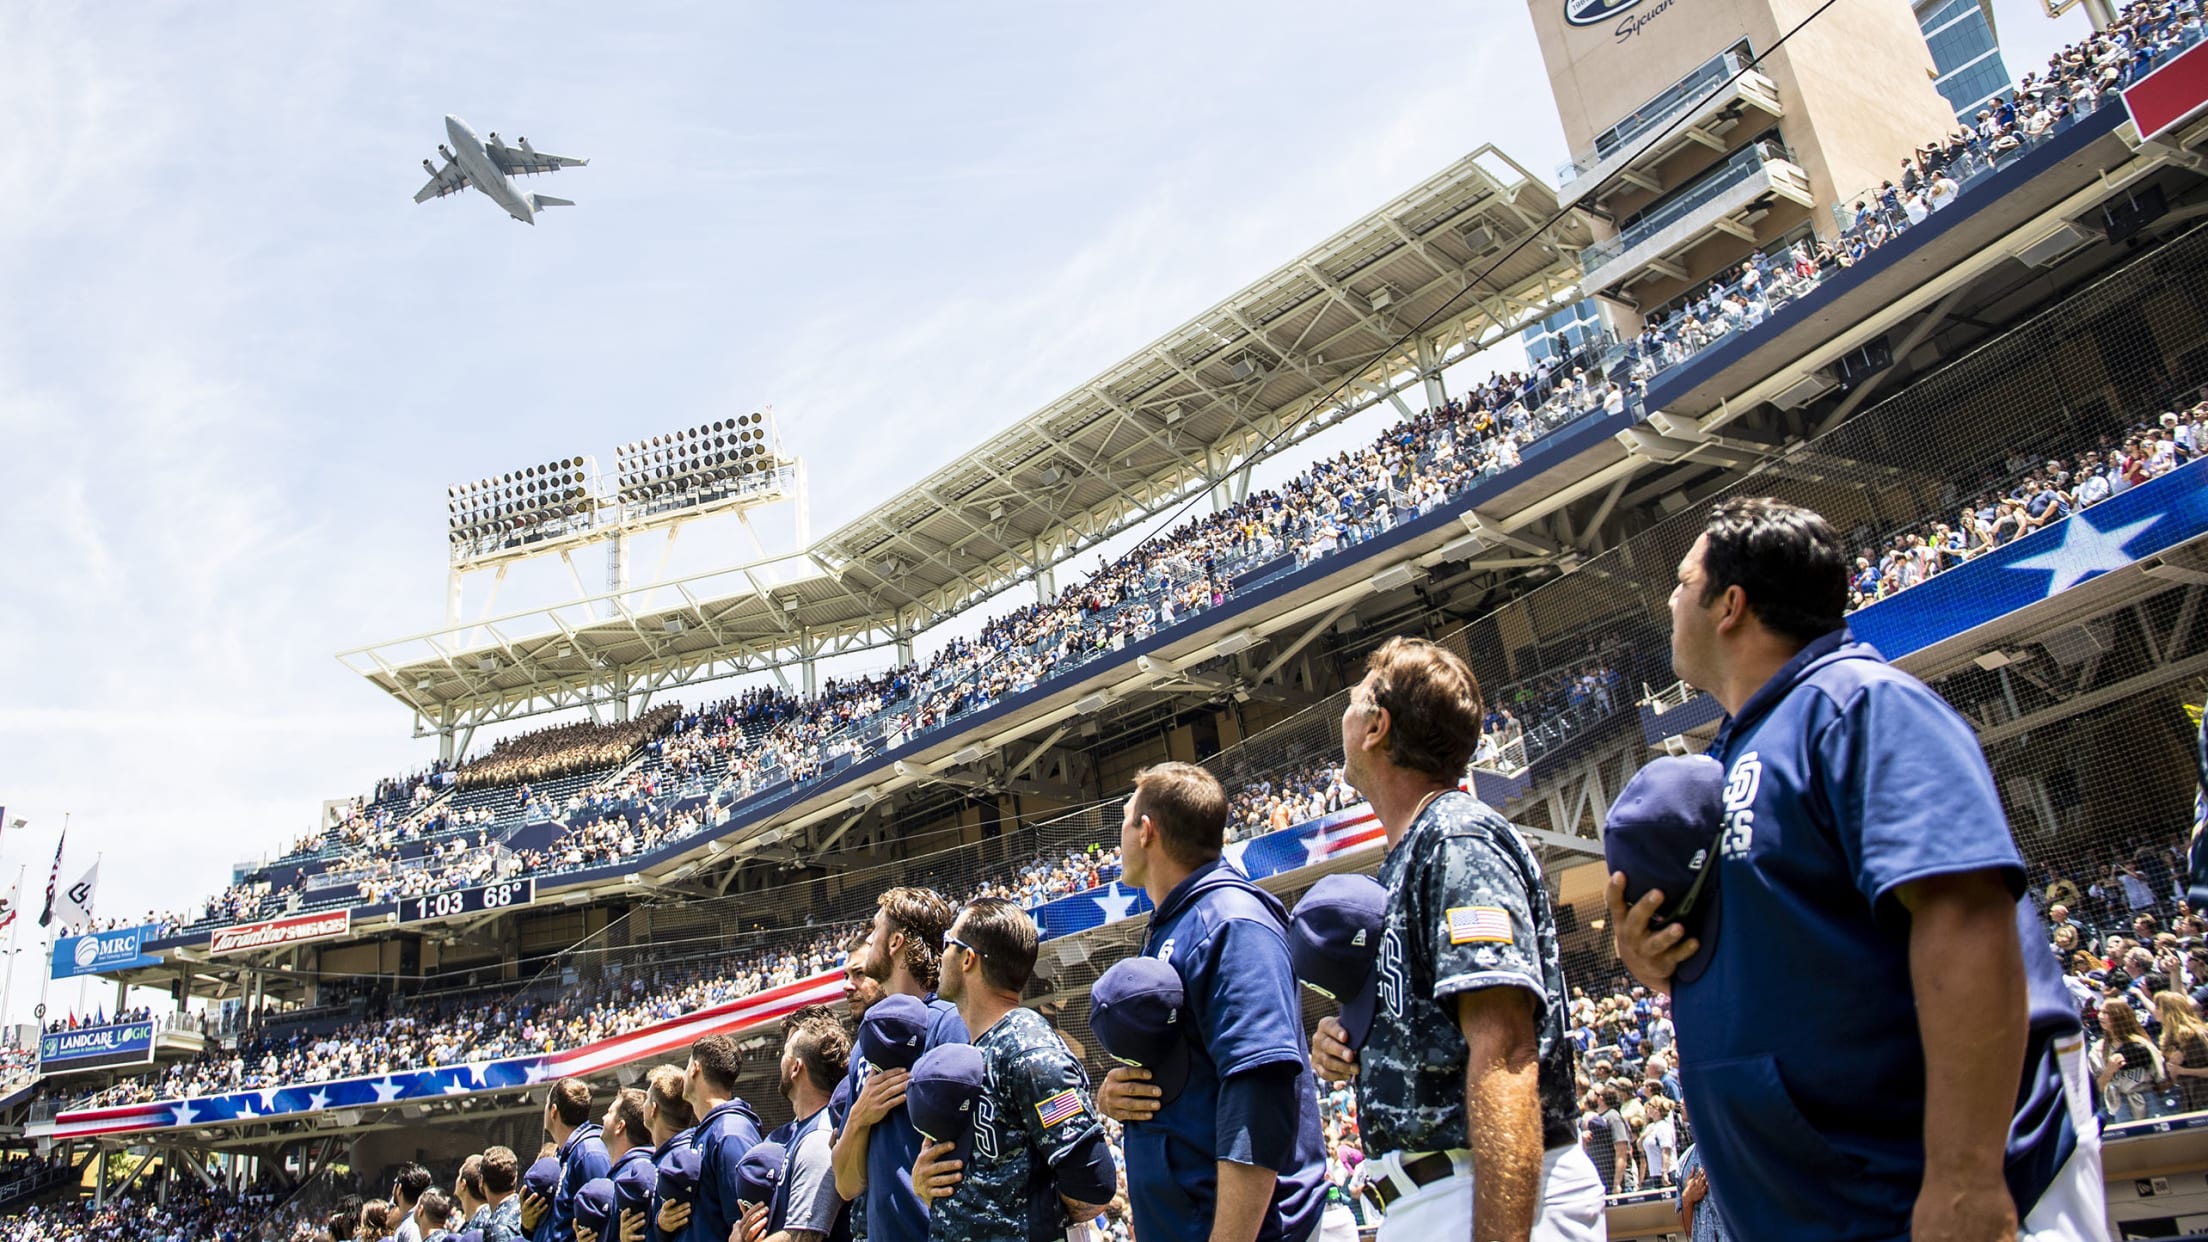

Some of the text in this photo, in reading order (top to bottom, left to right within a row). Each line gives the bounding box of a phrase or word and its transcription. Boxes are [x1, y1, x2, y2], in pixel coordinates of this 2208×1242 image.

[1615, 0, 1675, 44] Sycuan
[416, 892, 464, 919] 1:03
[100, 935, 136, 955] MRC
[213, 923, 287, 950] Tarantino
[60, 1031, 113, 1050] LANDCARE
[117, 1025, 152, 1043] LOGIC
